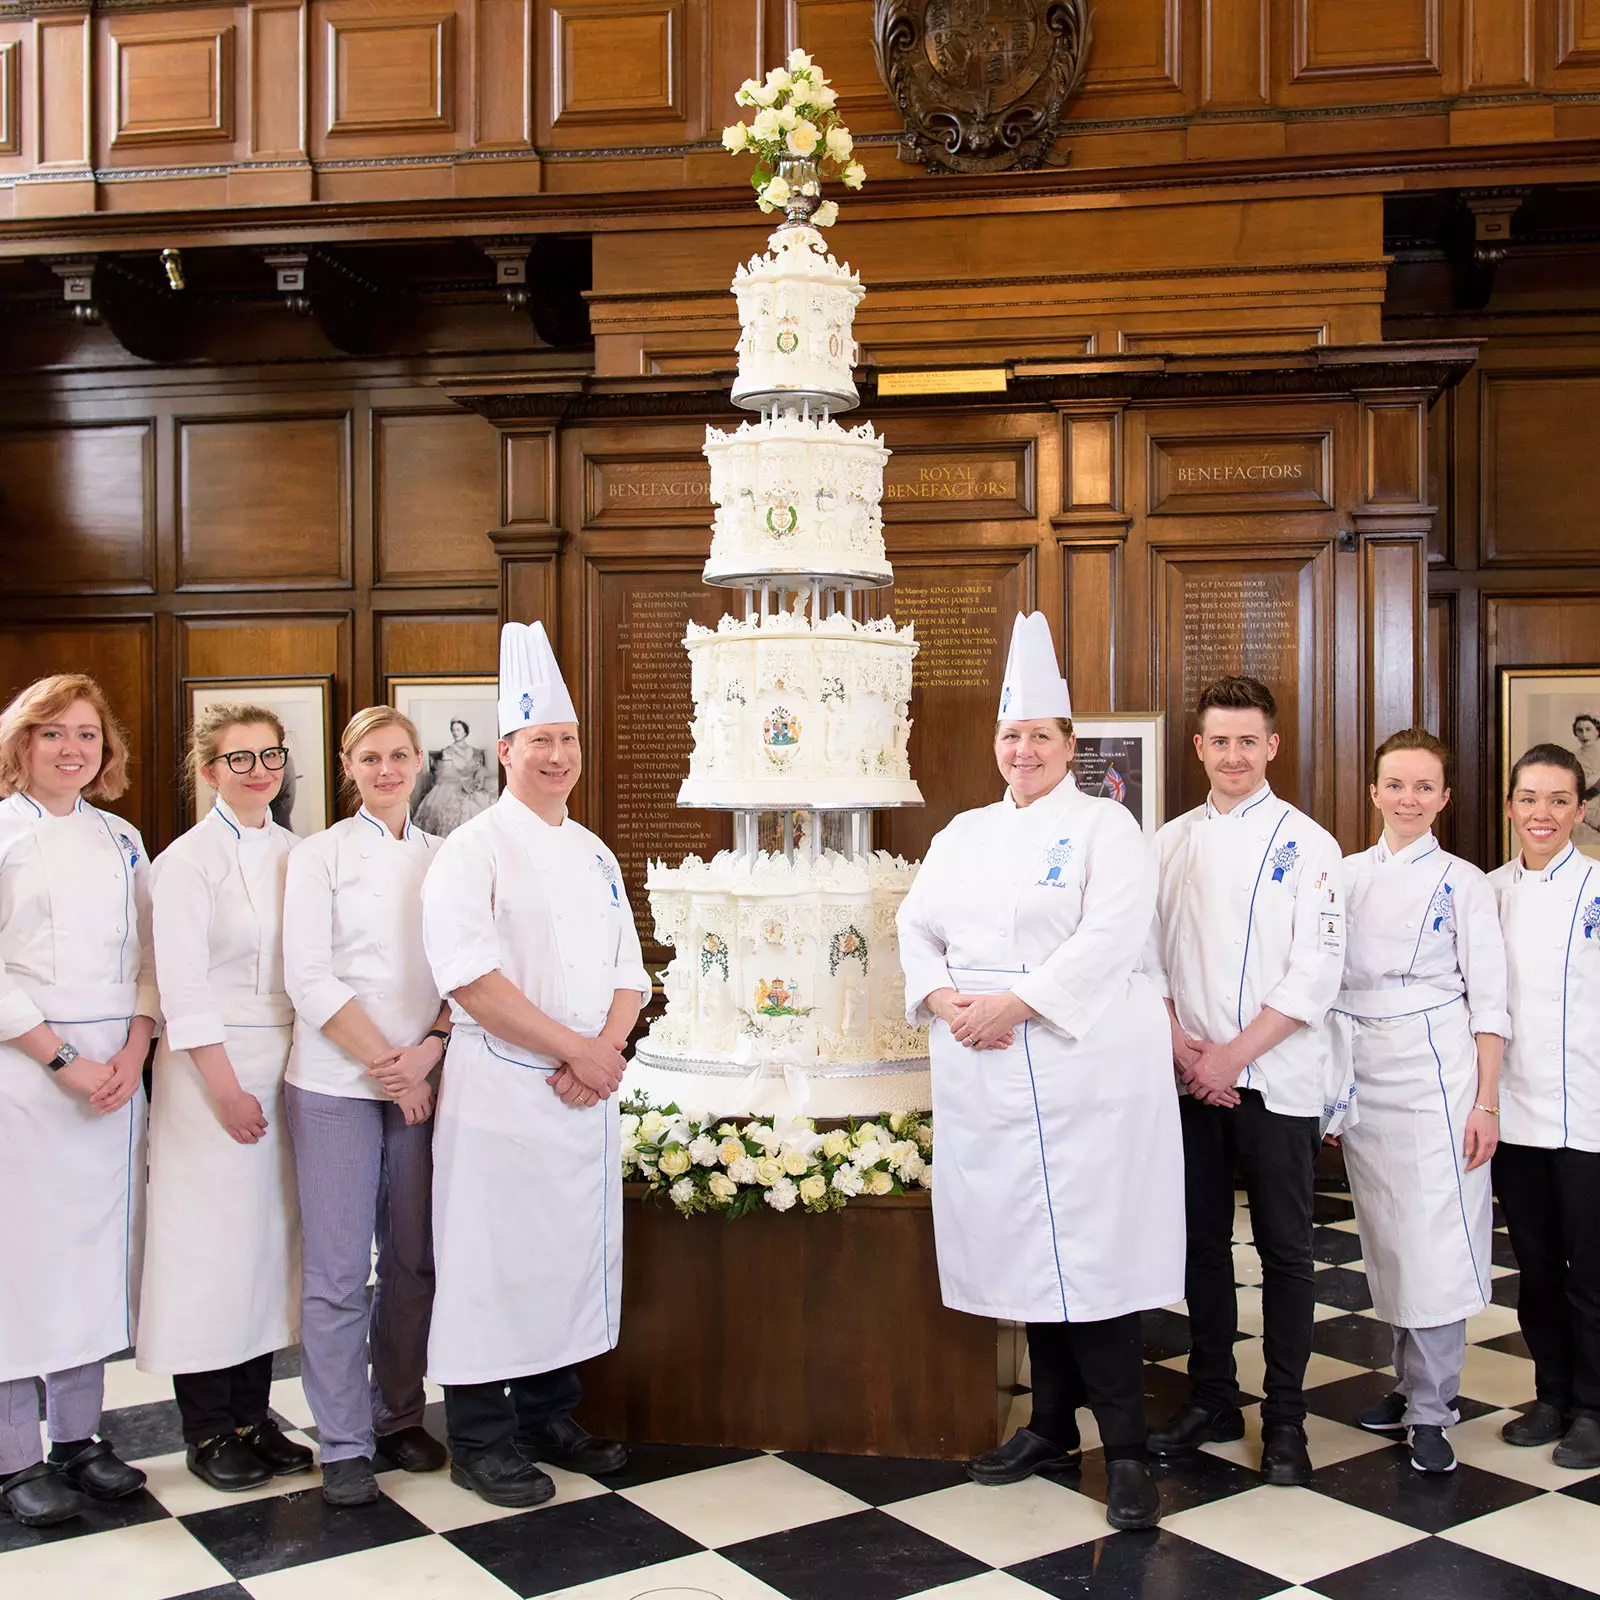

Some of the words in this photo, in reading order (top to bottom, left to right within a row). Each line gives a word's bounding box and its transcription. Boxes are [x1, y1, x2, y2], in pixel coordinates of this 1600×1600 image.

[920, 467, 972, 480] ROYAL
[1178, 465, 1302, 480] BENEFACTORS
[609, 482, 710, 496] BENEFACTOR
[888, 481, 1007, 497] BENEFACTORS
[950, 597, 974, 605] JAMES
[1272, 601, 1294, 609] JONG
[933, 639, 960, 647] QUEEN
[933, 670, 959, 678] QUEEN
[632, 693, 656, 701] MAJOR
